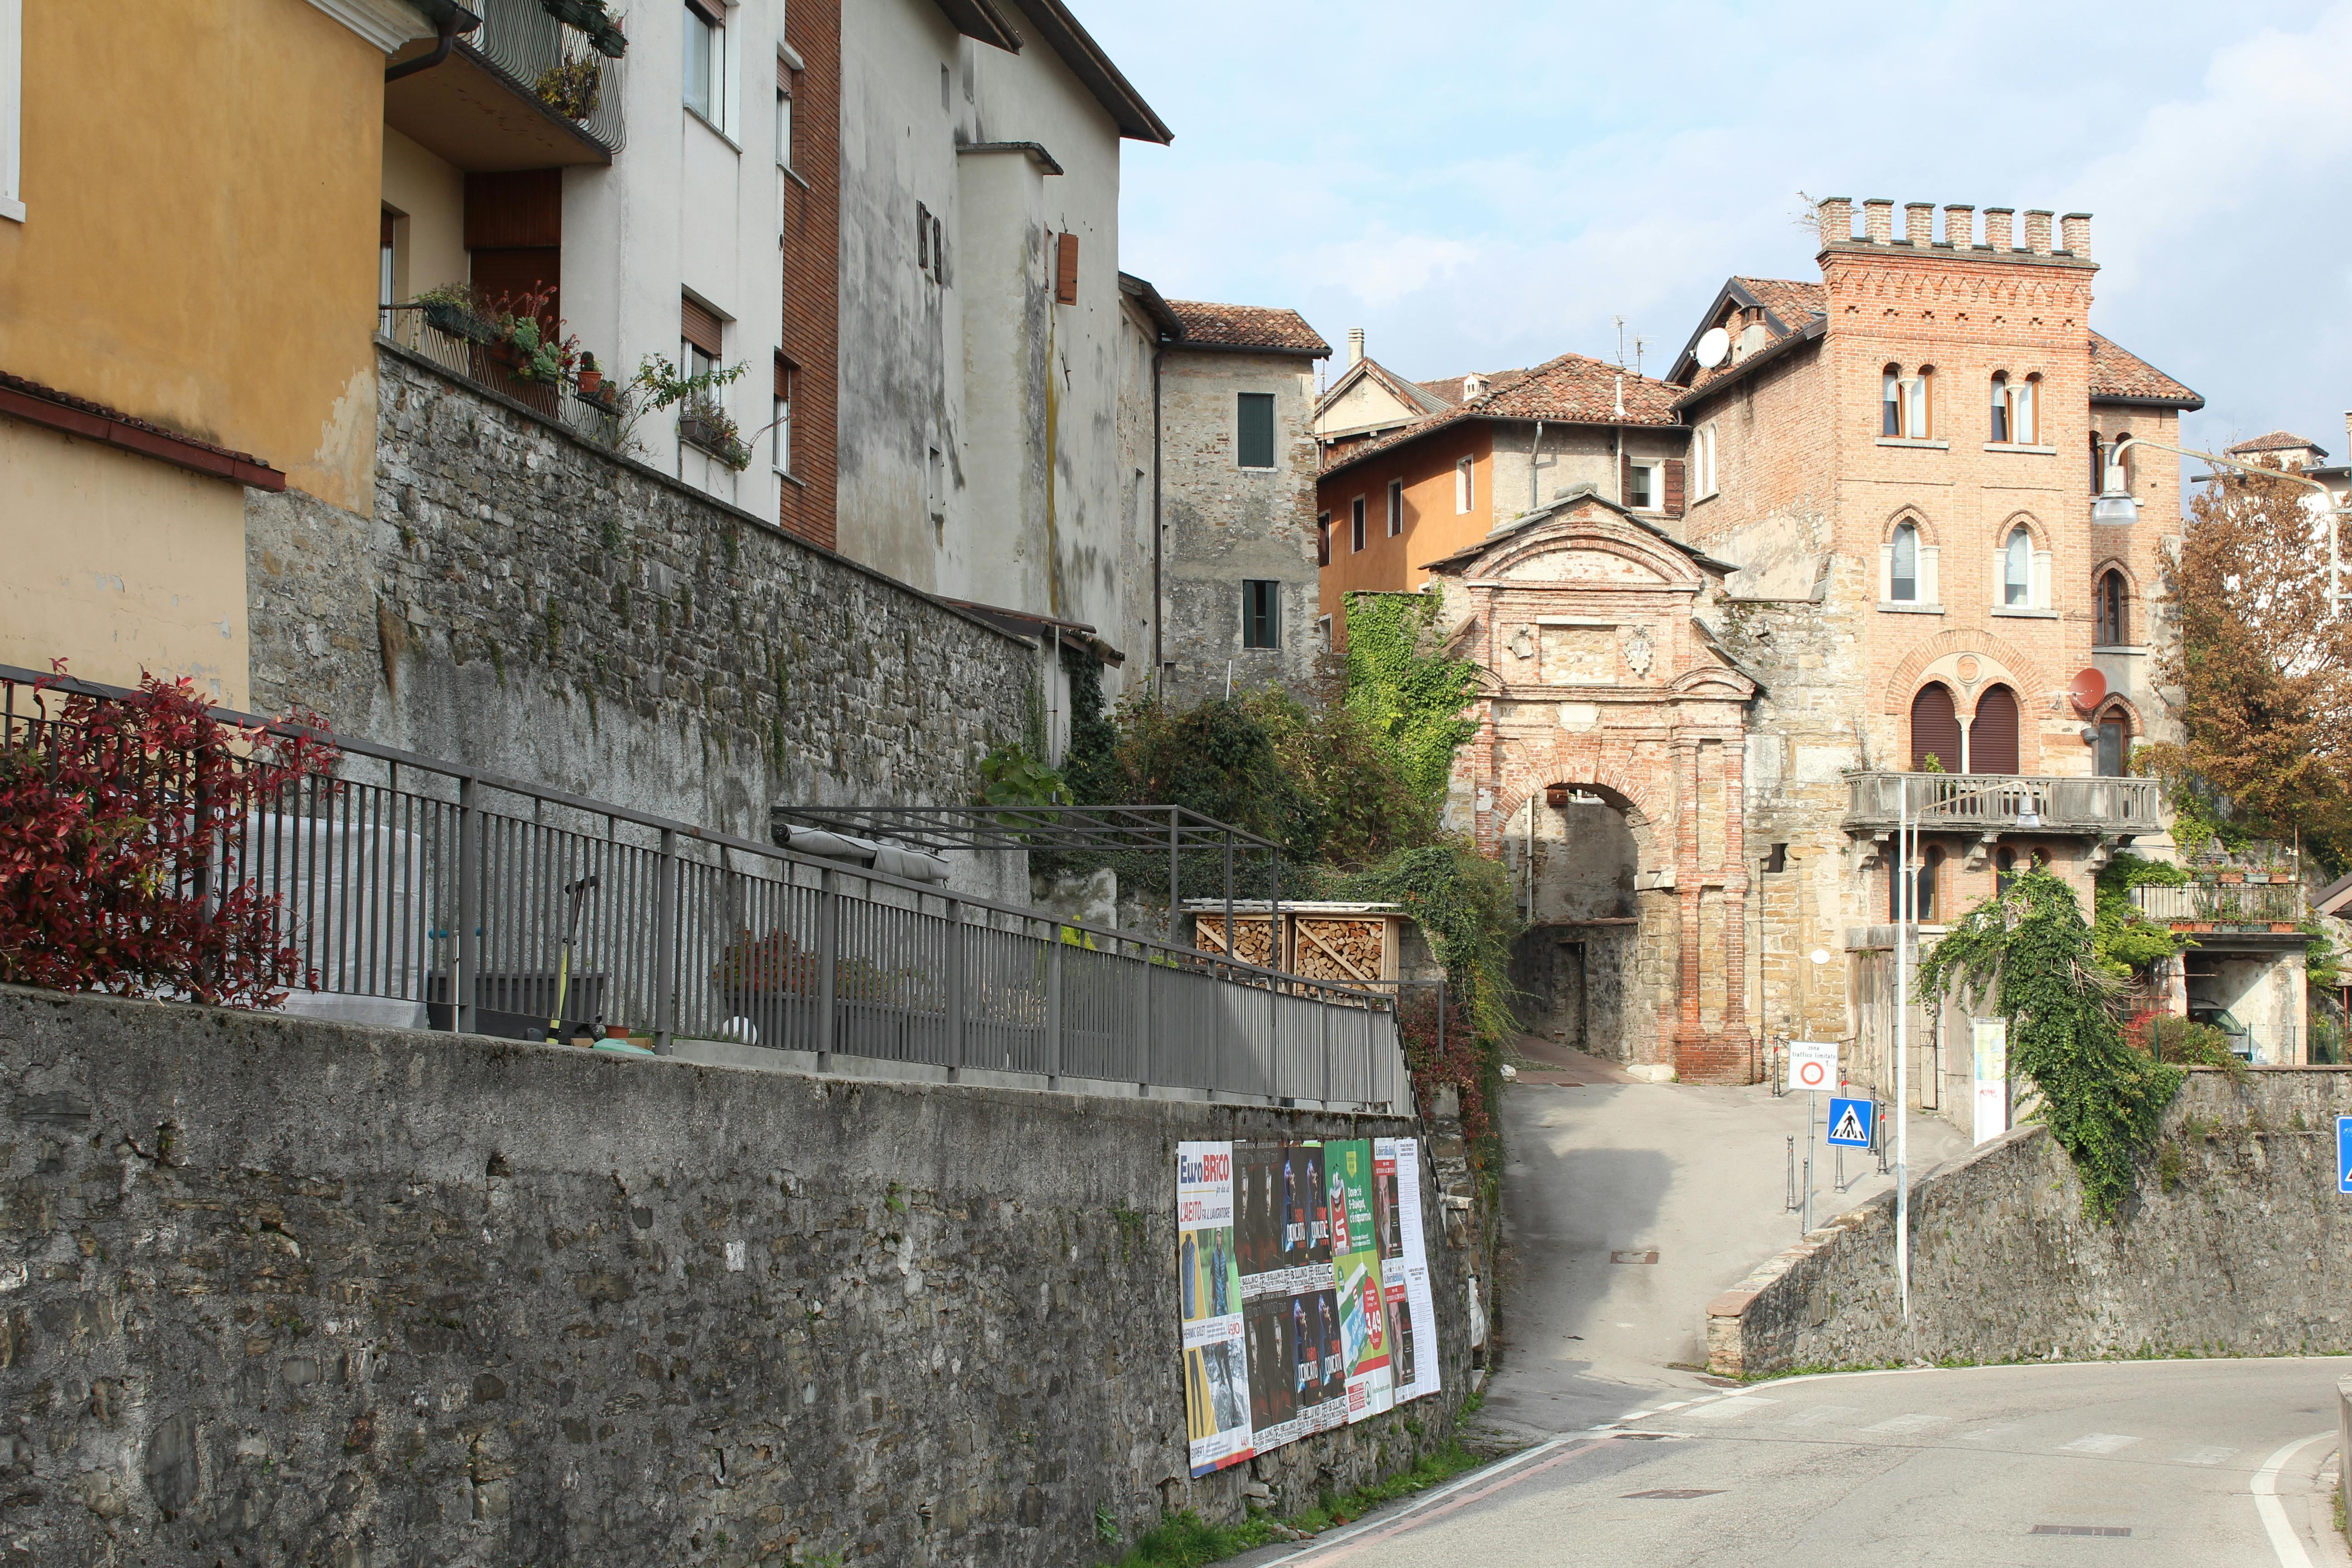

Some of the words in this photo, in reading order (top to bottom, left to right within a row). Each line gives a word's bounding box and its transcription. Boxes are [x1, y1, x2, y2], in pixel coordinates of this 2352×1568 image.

[1348, 1186, 1357, 1197] Dove
[1180, 1200, 1202, 1222] L'ABITO
[1366, 1310, 1382, 1338] 3,49
[1191, 1445, 1205, 1459] EXPERT
